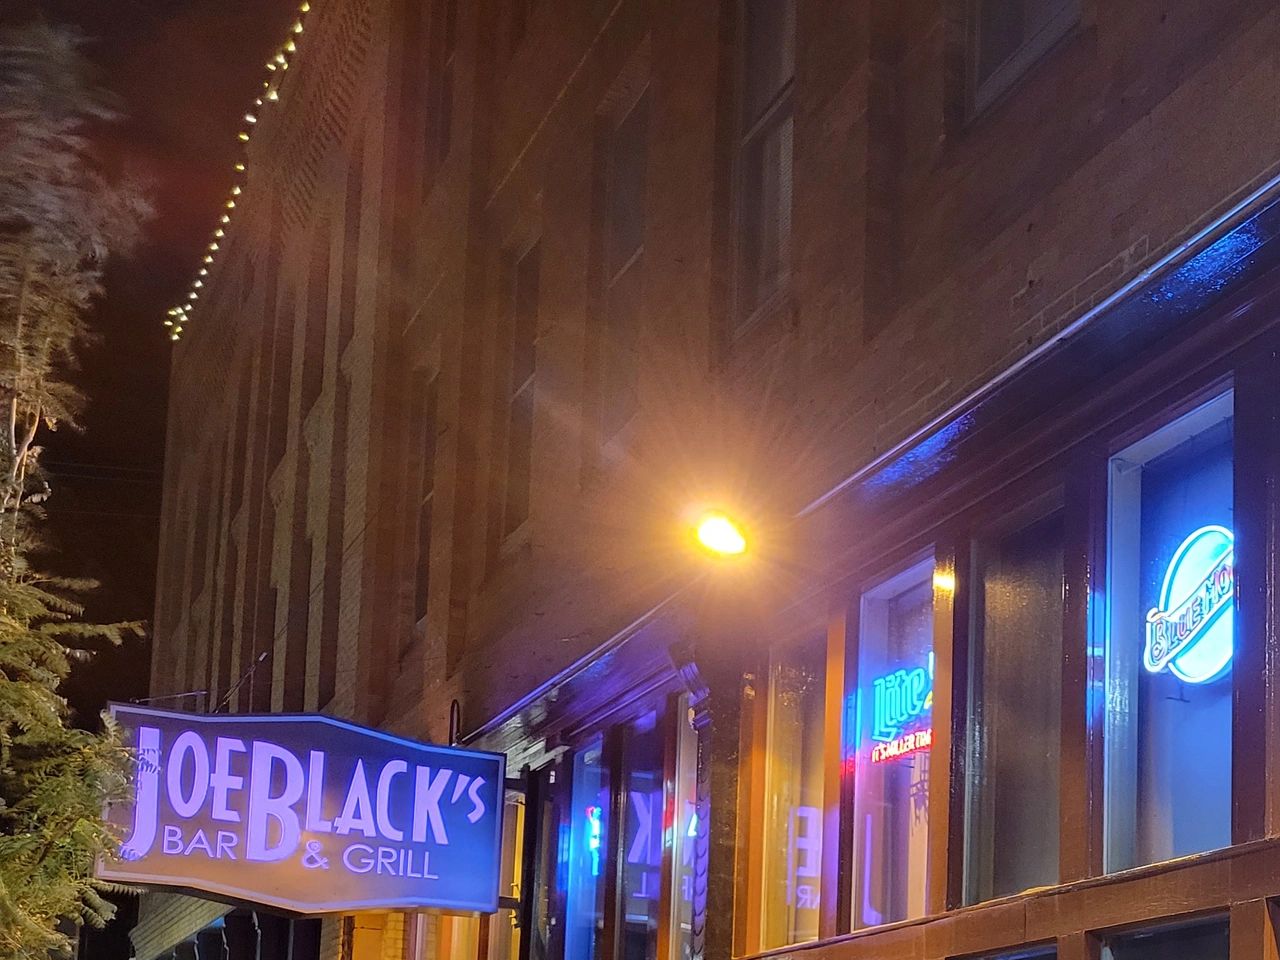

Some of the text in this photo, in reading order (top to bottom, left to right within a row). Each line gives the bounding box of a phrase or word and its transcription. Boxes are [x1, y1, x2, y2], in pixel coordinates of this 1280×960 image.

[1151, 597, 1204, 667] BLUE
[162, 825, 440, 880] BAR & GRILL
